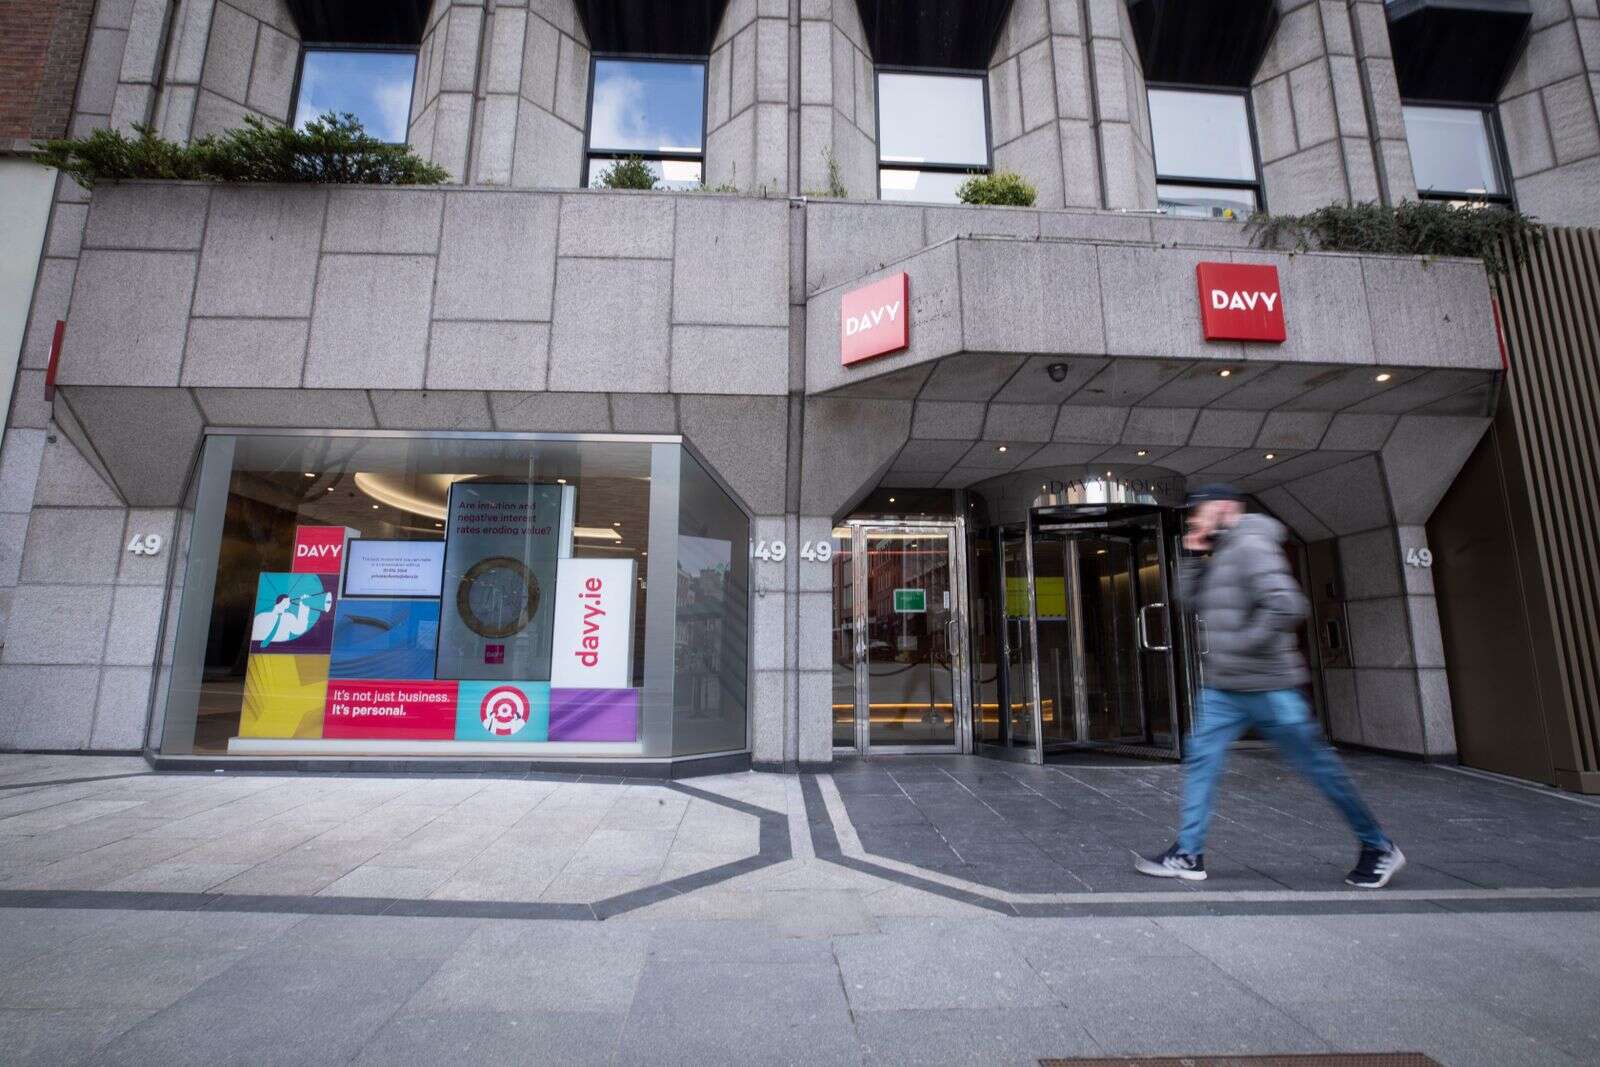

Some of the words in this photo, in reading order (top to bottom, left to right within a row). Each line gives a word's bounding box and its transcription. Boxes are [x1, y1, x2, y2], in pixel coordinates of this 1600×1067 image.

[1211, 288, 1278, 312] DAVY
[846, 300, 900, 336] DAVY
[1050, 477, 1105, 494] DAVY
[459, 501, 476, 510] Are
[457, 512, 498, 523] negative
[456, 524, 481, 535] rates
[482, 524, 519, 536] eroding
[128, 534, 162, 555] 49
[297, 543, 343, 558] DAVY
[754, 540, 786, 562] 49
[800, 540, 832, 562] 49
[1406, 547, 1433, 567] 49
[575, 577, 606, 668] davy.ie
[333, 689, 350, 701] It's
[352, 690, 371, 702] not
[374, 690, 396, 704] just
[397, 690, 451, 703] business.
[331, 703, 350, 716] It's
[351, 703, 407, 718] personal.
